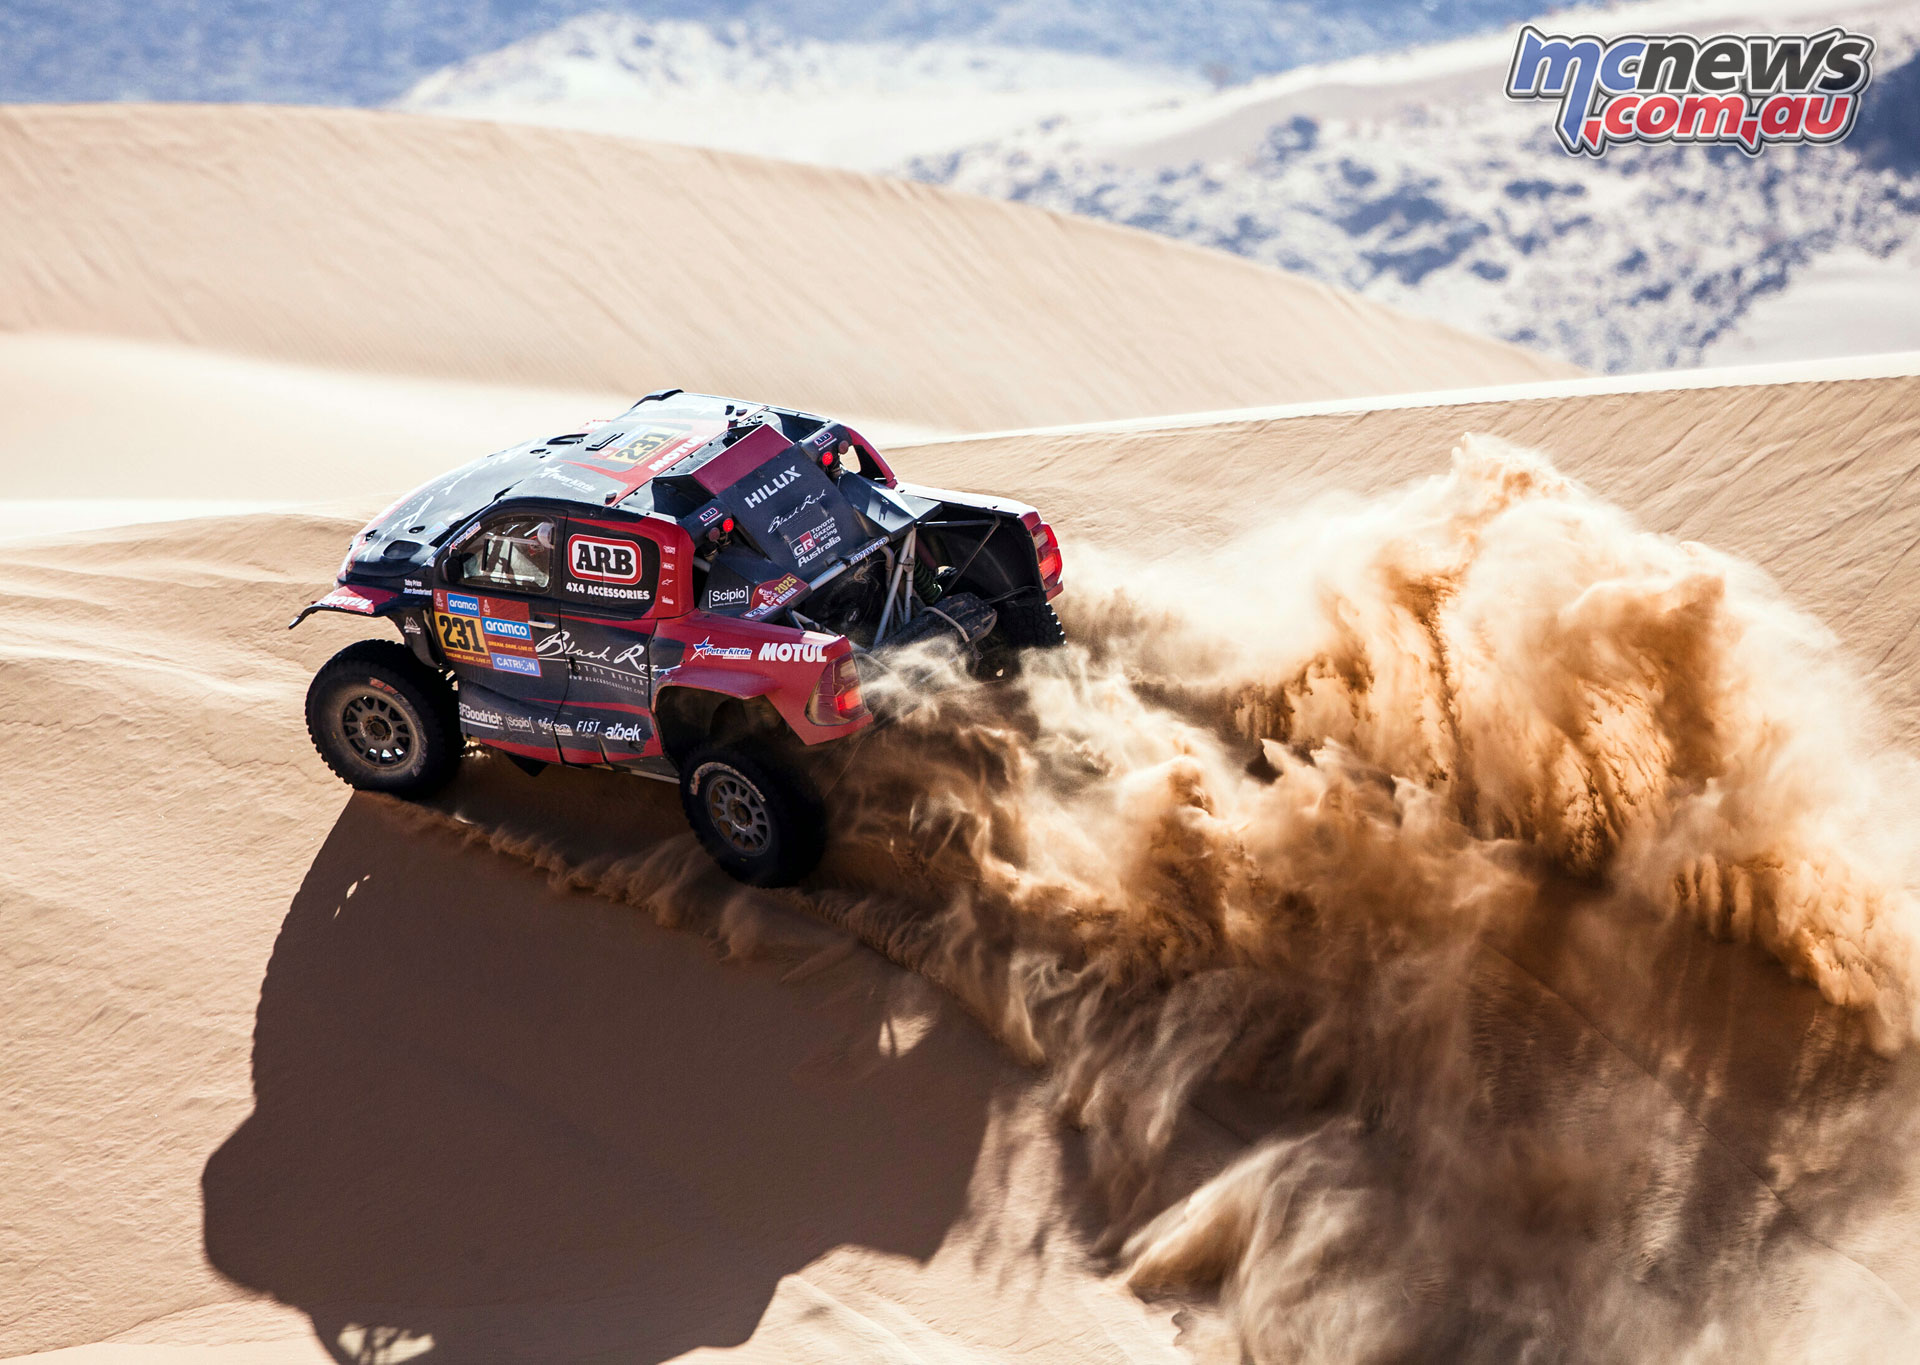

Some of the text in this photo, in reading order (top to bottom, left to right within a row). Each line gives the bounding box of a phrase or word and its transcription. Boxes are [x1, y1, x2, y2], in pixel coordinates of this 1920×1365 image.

[615, 432, 672, 460] 231
[648, 435, 709, 472] MOTUL
[744, 465, 802, 509] HILUX
[701, 508, 717, 521] ARB
[810, 516, 835, 534] TOYOTA
[813, 523, 836, 540] GAZOO
[793, 538, 815, 557] GR
[797, 535, 842, 568] Australia
[576, 544, 633, 575] ARB
[566, 581, 650, 600] 4X4 ACCESSORIES
[774, 576, 798, 594] 2025
[449, 599, 477, 611] aramco
[439, 614, 485, 653] 231
[485, 621, 527, 636] aramco
[535, 629, 611, 661] Black
[758, 643, 827, 662] MOTUL
[497, 657, 536, 671] CATRION
[576, 720, 600, 733] FIST
